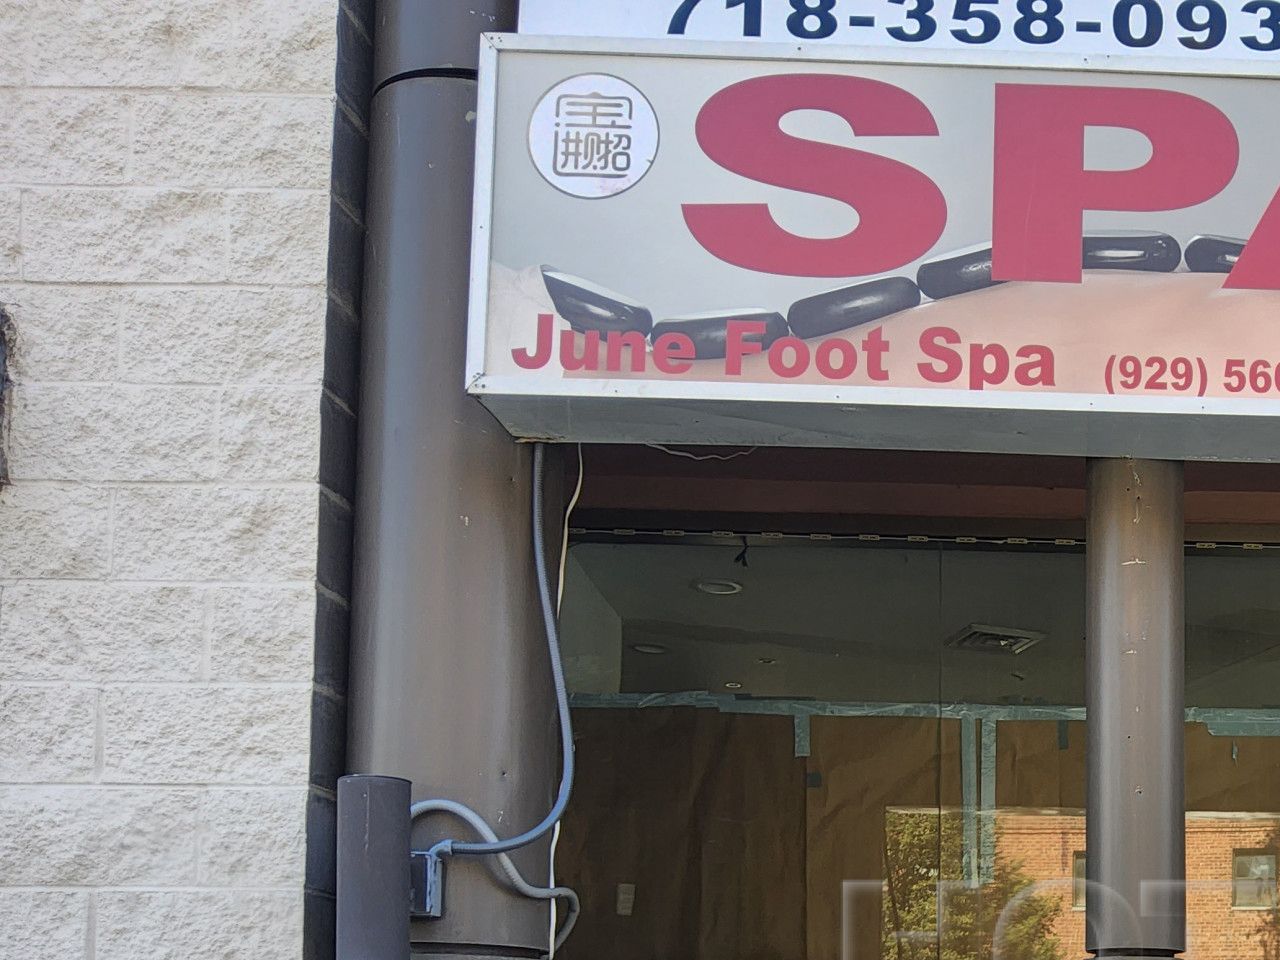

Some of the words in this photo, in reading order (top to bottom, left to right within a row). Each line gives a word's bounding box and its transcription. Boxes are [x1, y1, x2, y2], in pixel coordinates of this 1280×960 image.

[511, 313, 696, 375] June
[725, 319, 890, 381] Foot
[917, 326, 1056, 390] Spa
[1104, 354, 1208, 397] (929)
